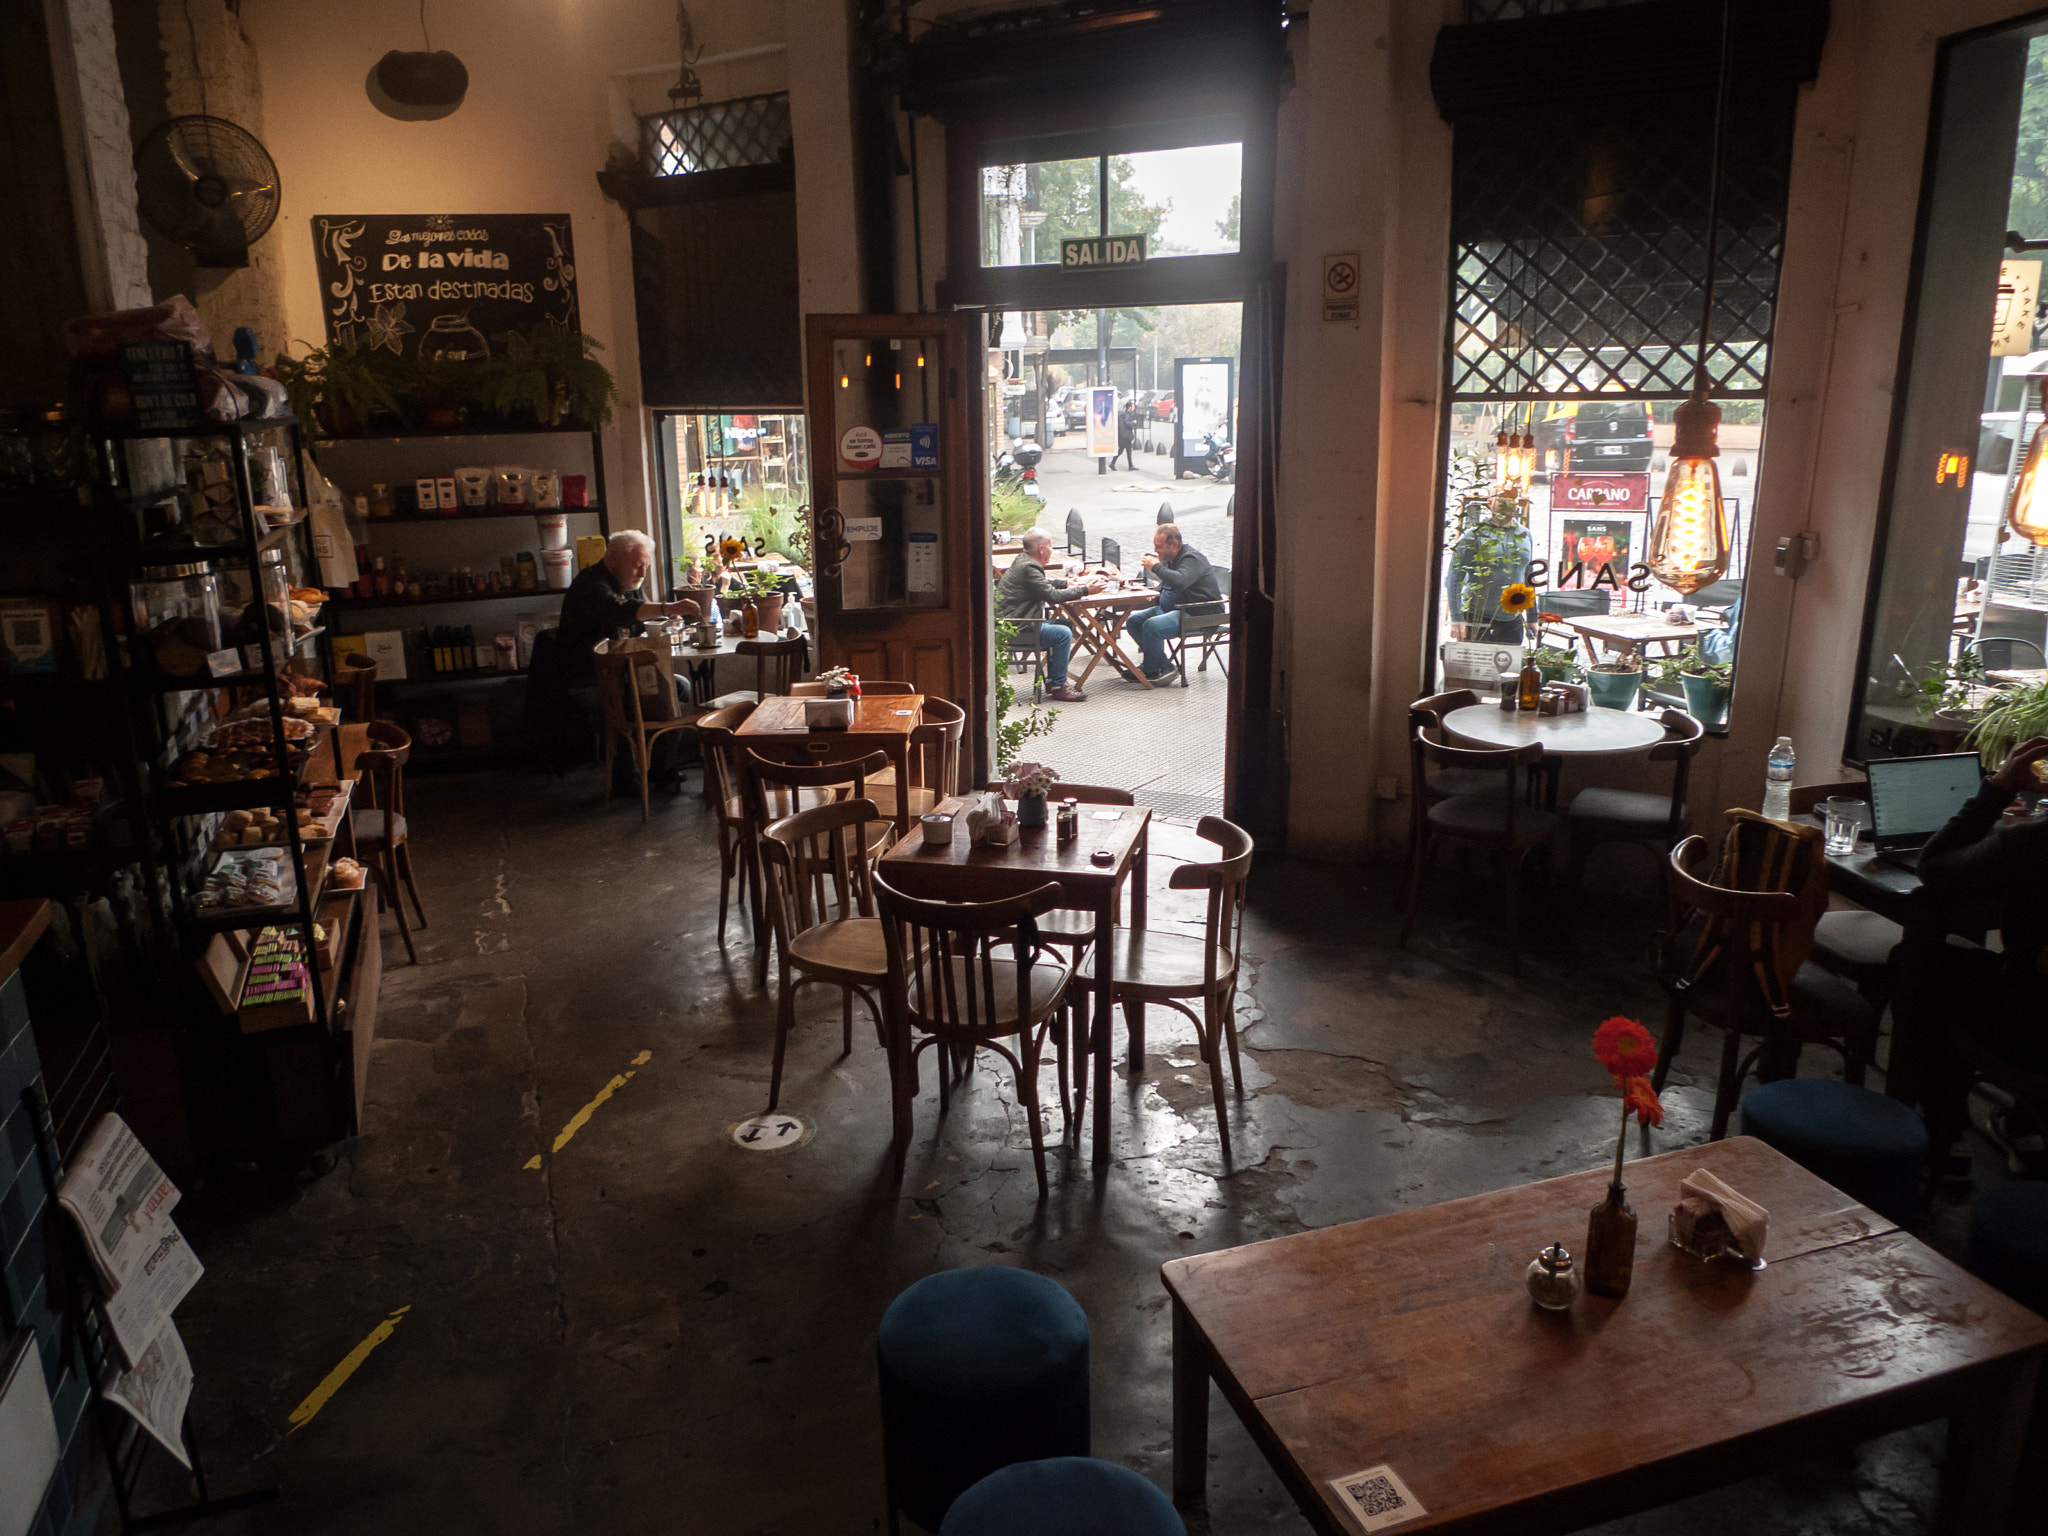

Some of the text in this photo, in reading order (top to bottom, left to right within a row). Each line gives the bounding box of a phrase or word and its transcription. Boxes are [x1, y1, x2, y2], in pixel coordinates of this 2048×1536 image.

[411, 231, 456, 247] mejores
[456, 228, 489, 241] cosas
[382, 247, 509, 271] De la vida
[1065, 240, 1141, 266] SALIDA
[369, 280, 534, 303] Estan destinadas
[724, 426, 758, 441] Nipa
[914, 456, 937, 466] VISA
